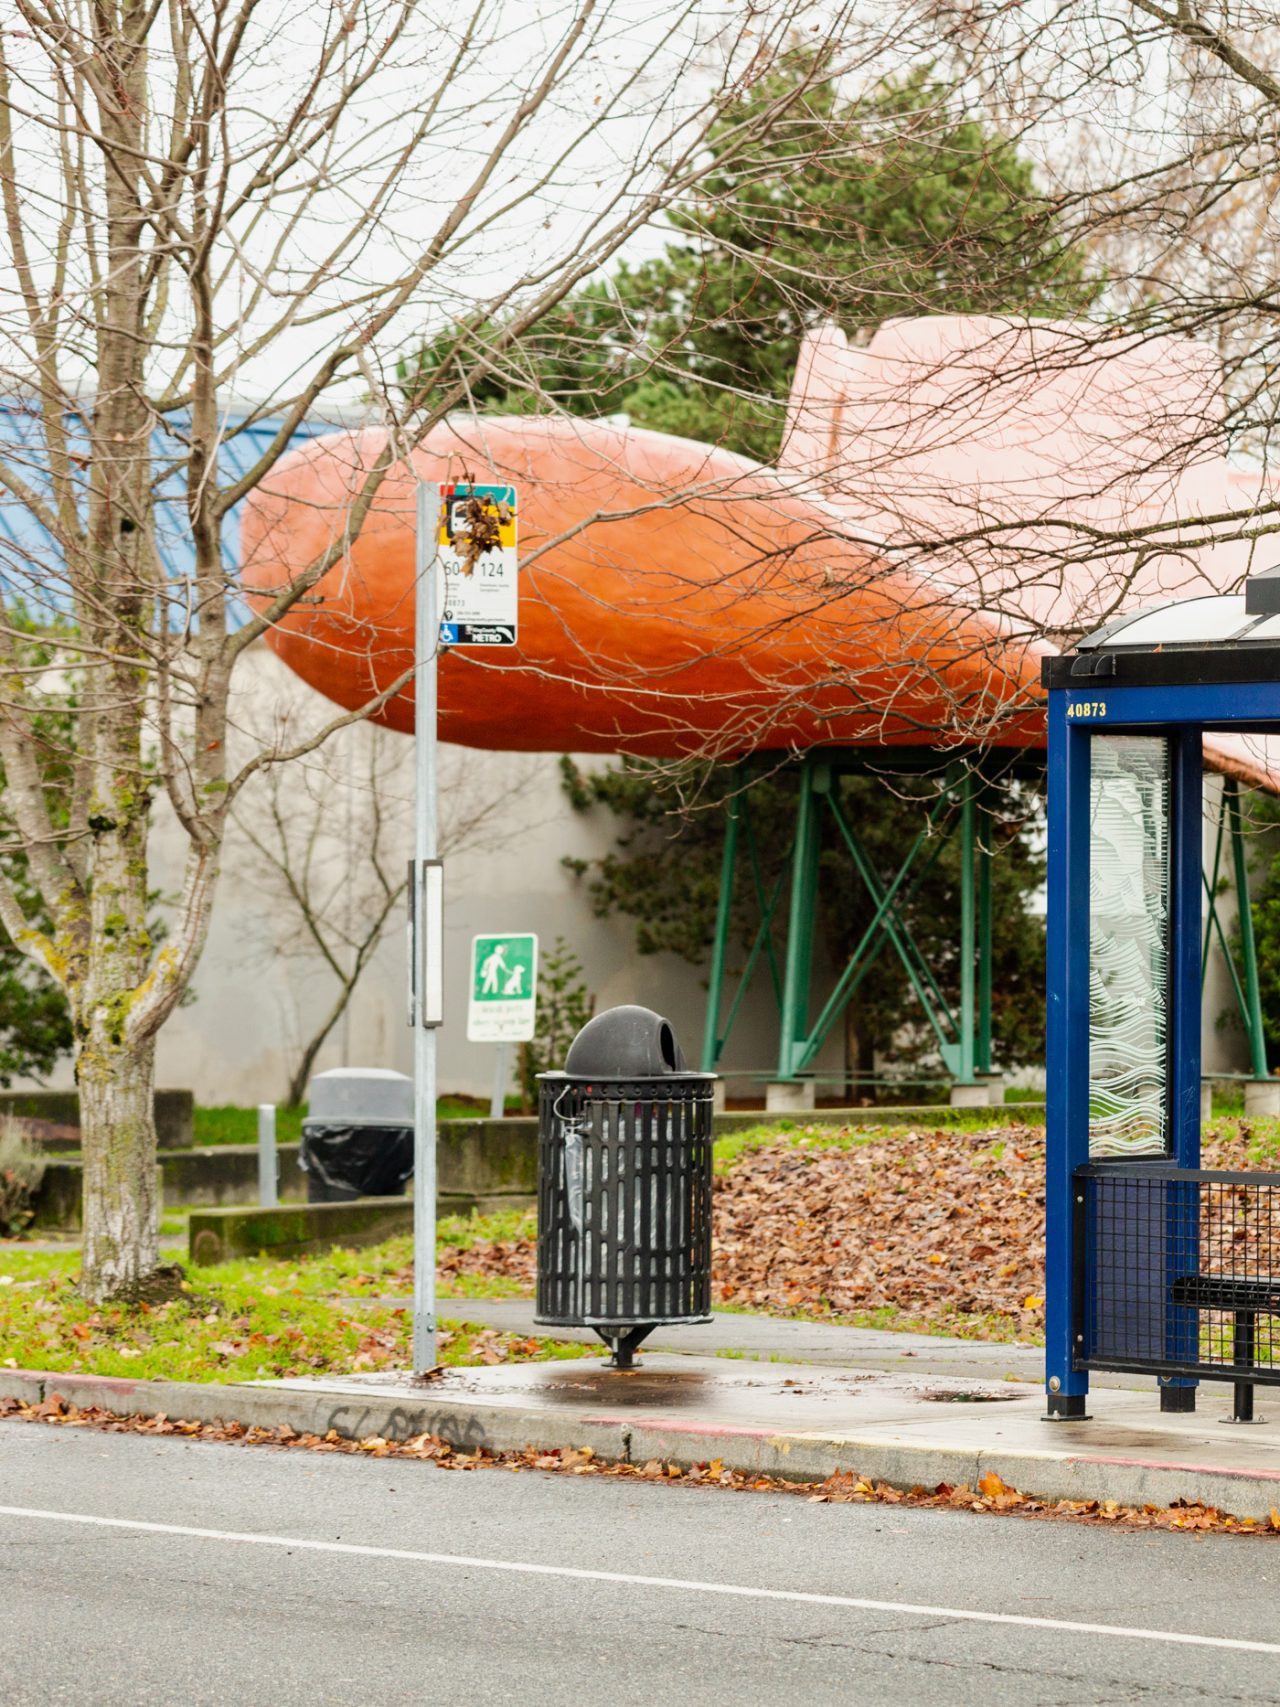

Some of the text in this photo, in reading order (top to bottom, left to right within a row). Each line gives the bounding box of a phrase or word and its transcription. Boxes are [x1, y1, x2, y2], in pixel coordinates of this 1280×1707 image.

[481, 562, 504, 577] 124
[472, 633, 502, 642] METRO
[1067, 702, 1106, 718] 40873
